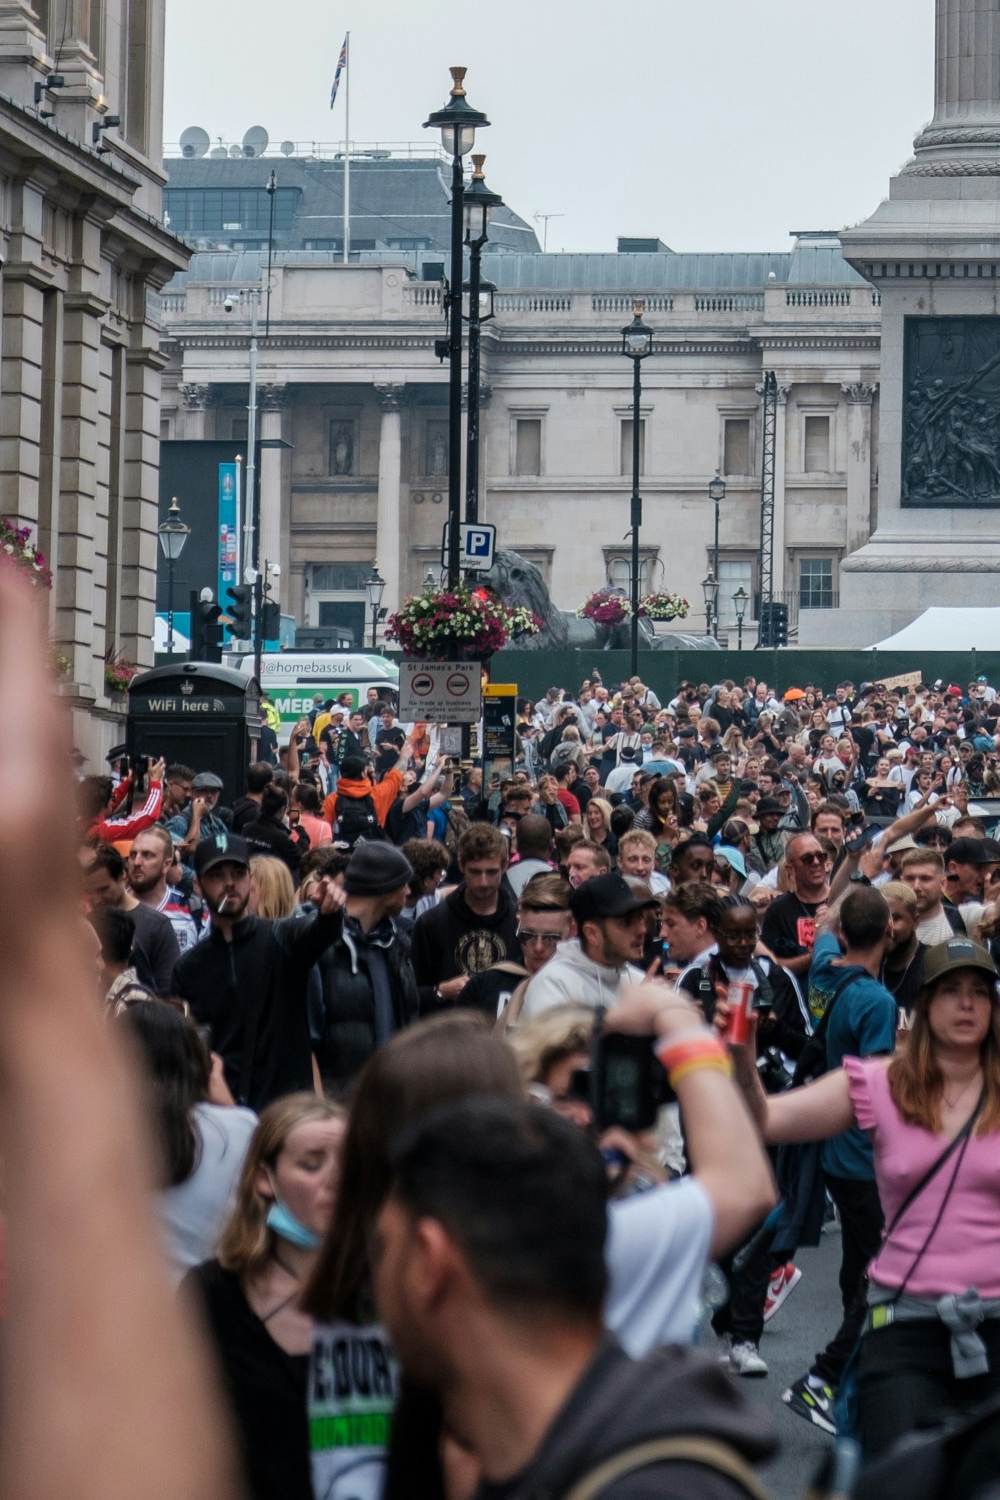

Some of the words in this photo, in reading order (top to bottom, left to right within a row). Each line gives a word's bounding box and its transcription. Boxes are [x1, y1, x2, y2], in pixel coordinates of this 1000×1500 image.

[470, 533, 486, 554] P
[265, 662, 352, 676] @homebassuk
[407, 664, 417, 672] St
[420, 664, 452, 672] James's
[455, 664, 474, 672] Park
[182, 699, 209, 712] here
[274, 699, 314, 713] MEB
